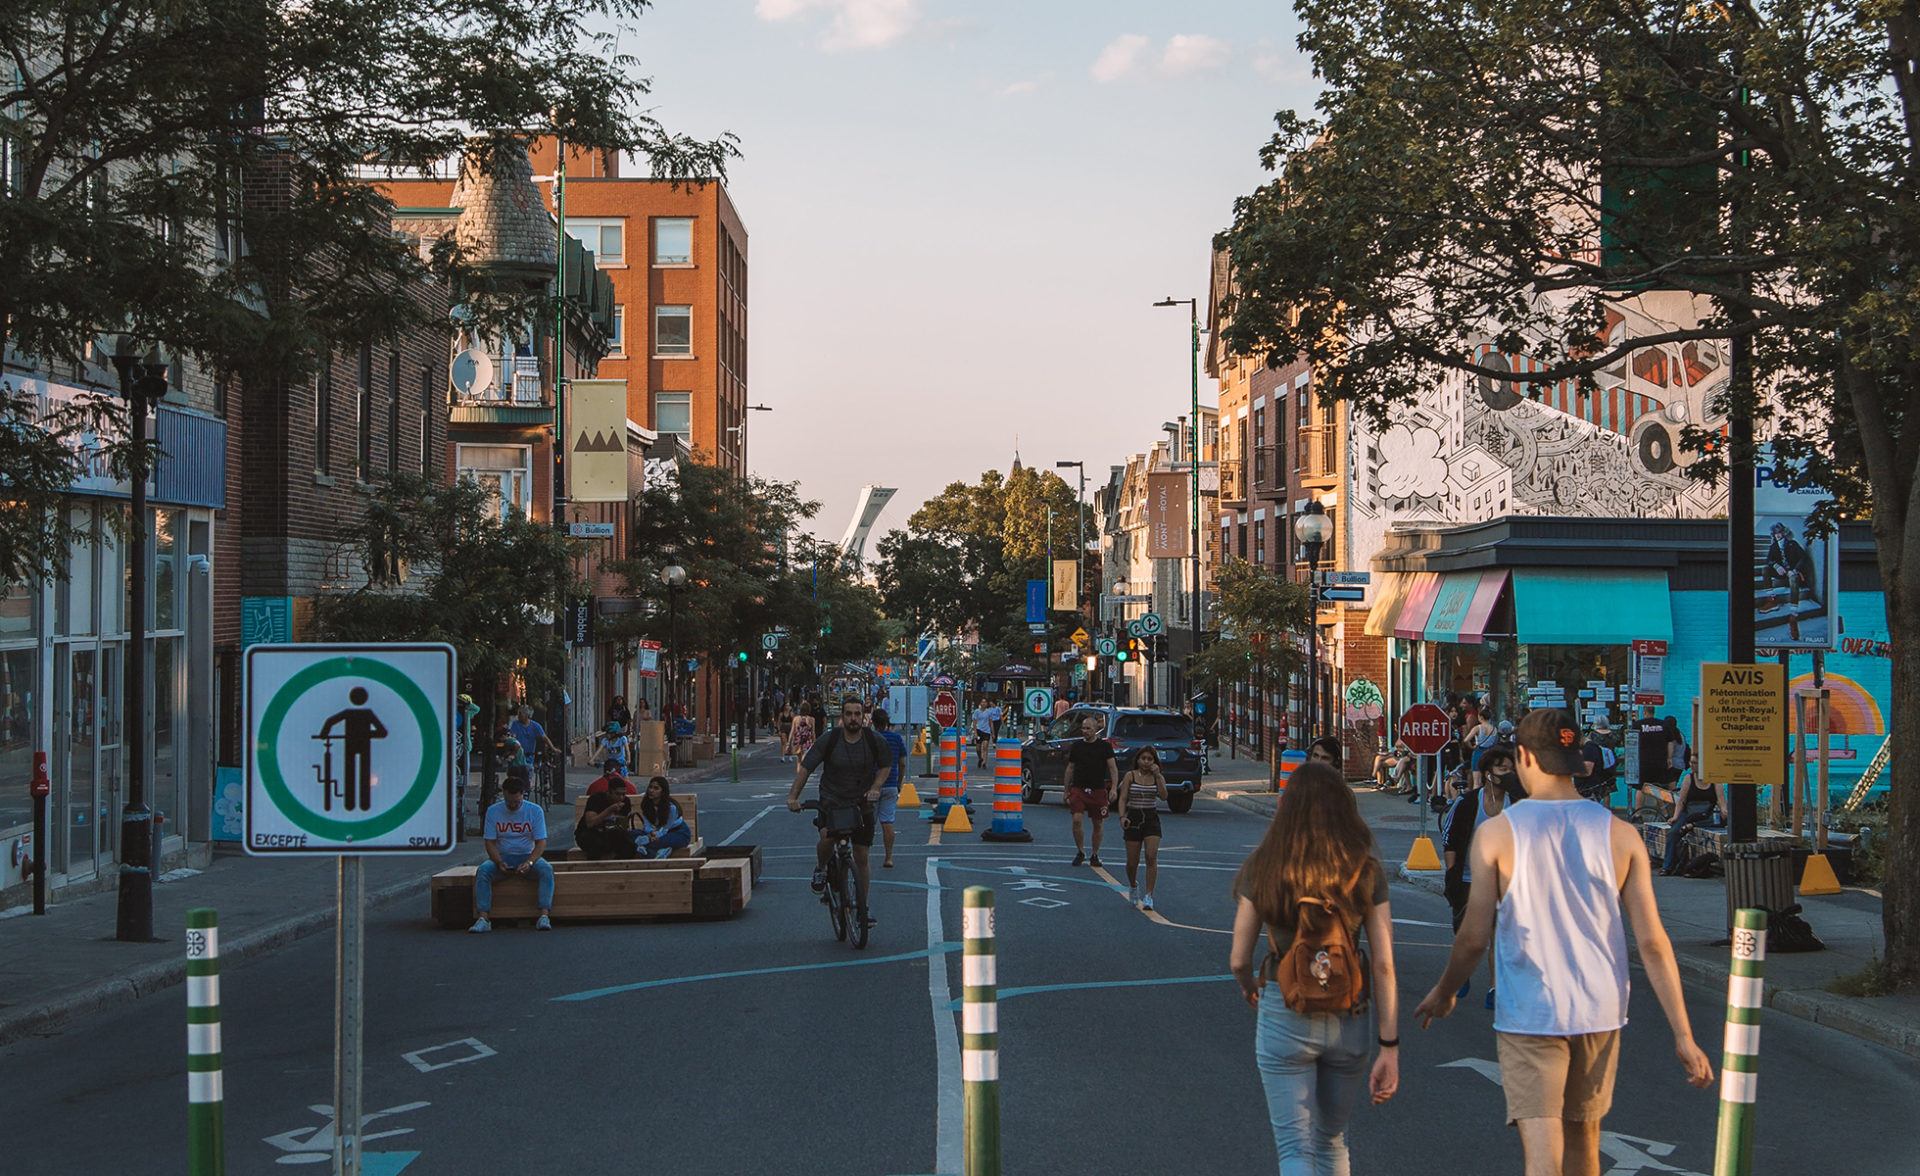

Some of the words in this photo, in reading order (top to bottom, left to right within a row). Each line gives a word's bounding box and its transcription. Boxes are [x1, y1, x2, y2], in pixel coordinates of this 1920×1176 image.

[585, 526, 610, 534] Bullion
[577, 606, 587, 642] bubbles
[1841, 637, 1874, 656] OVER
[1721, 670, 1764, 685] AVIS
[1710, 688, 1776, 697] Piétonnisation
[1718, 697, 1730, 705] de
[1732, 697, 1768, 705] l'avenue
[936, 703, 956, 716] ARRÊT
[1708, 705, 1720, 714] du
[1721, 706, 1777, 715] Mont-Royal,
[1402, 719, 1448, 737] ARRÊT
[1721, 722, 1765, 731] Chapleau
[496, 822, 531, 833] NASA
[255, 833, 308, 847] EXCEPTÉ
[408, 836, 440, 848] SPVM
